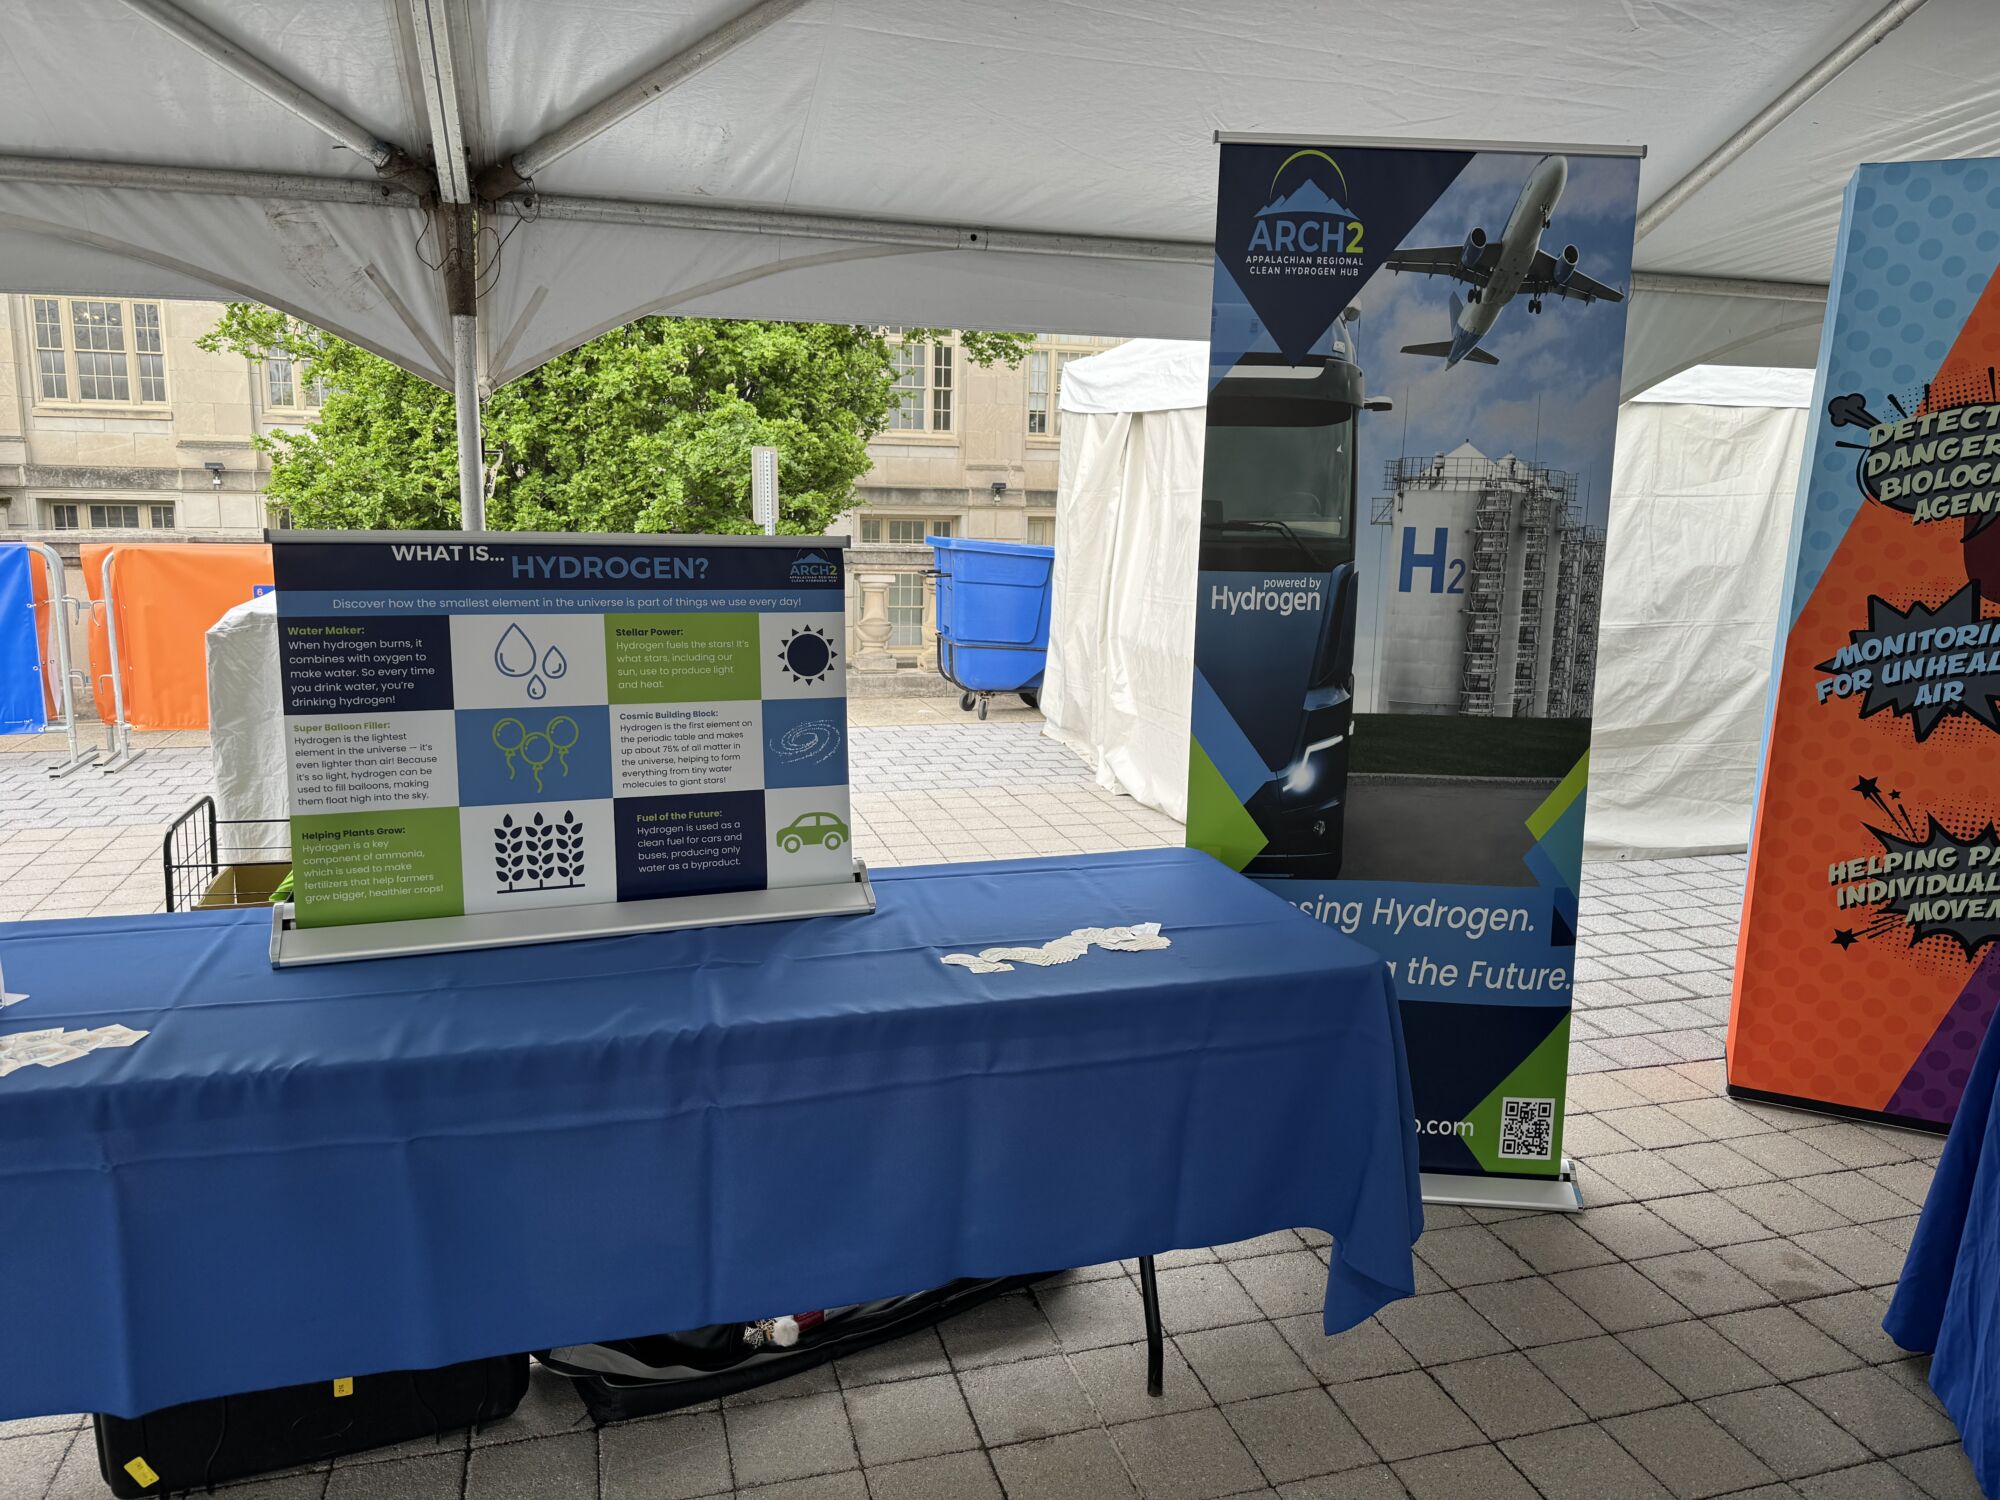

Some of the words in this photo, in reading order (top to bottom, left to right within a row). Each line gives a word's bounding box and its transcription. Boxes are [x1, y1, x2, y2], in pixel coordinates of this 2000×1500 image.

[1248, 220, 1364, 253] ARCH2
[1246, 255, 1312, 264] APPALACHIAN
[1316, 257, 1364, 265] REGIONAL
[1249, 266, 1281, 274] CLEAN
[1285, 267, 1336, 275] HYDROGEN
[1340, 268, 1359, 276] HUB
[391, 545, 464, 562] WHAT
[469, 545, 504, 562] IS...
[512, 556, 708, 579] HYDROGEN?
[790, 564, 838, 576] ARCH2
[1263, 578, 1307, 590] powered
[1309, 577, 1321, 590] by
[333, 599, 385, 608] Discover
[388, 598, 414, 608] how
[417, 598, 436, 608] the
[439, 598, 489, 607] smallest
[491, 598, 540, 607] element
[542, 598, 552, 607] in
[555, 598, 574, 607] the
[577, 598, 624, 607] universe
[626, 598, 635, 606] is
[637, 598, 660, 609] part
[662, 597, 672, 606] of
[675, 597, 708, 609] things
[749, 599, 776, 608] every
[779, 596, 801, 608] day!
[1211, 585, 1321, 616] Hydrogen
[287, 627, 323, 635] Water
[325, 626, 364, 635] Maker:
[615, 628, 648, 636] Stellar
[650, 628, 683, 636] Power:
[288, 640, 320, 649] When
[323, 640, 377, 651] hydrogen
[379, 639, 413, 649] burns,
[415, 639, 422, 648] it
[289, 654, 344, 663] combines
[347, 653, 370, 662] with
[373, 655, 412, 664] oxygen
[415, 653, 426, 661] to
[290, 669, 322, 678] make
[324, 669, 359, 677] water.
[361, 668, 375, 676] So
[377, 669, 408, 678] every
[410, 667, 435, 675] time
[290, 685, 311, 694] you
[314, 682, 342, 691] drink
[344, 683, 378, 691] water,
[380, 681, 414, 692] you're
[1816, 668, 1872, 702] FOR
[1914, 680, 1964, 706] AIR
[291, 697, 336, 708] drinking
[339, 696, 395, 707] hydrogen!
[619, 712, 653, 720] Cosmic
[655, 711, 691, 720] Building
[692, 709, 718, 718] Block:
[293, 725, 322, 734] Super
[324, 722, 362, 731] Balloon
[363, 721, 390, 729] Filler:
[620, 723, 662, 733] Hydrogen
[664, 722, 671, 730] is
[688, 721, 704, 729] first
[706, 720, 740, 728] element
[294, 736, 341, 746] Hydrogen
[353, 734, 369, 742] the
[371, 733, 407, 744] lightest
[620, 735, 635, 743] the
[636, 734, 672, 744] periodic
[674, 733, 696, 741] table
[697, 732, 714, 740] and
[716, 731, 744, 739] makes
[634, 746, 660, 754] about
[662, 745, 679, 753] 75%
[681, 744, 689, 752] of
[321, 759, 352, 770] lighter
[354, 758, 377, 766] than
[621, 758, 636, 766] the
[677, 755, 709, 764] helping
[721, 753, 740, 761] form
[296, 773, 310, 781] it's
[325, 771, 349, 781] light,
[351, 770, 397, 780] hydrogen
[622, 768, 668, 778] everything
[669, 767, 690, 775] from
[691, 766, 707, 775] tiny
[622, 780, 667, 788] molecules
[679, 778, 701, 788] giant
[703, 777, 726, 785] stars!
[636, 813, 657, 822] Fuel
[658, 812, 669, 820] of
[670, 812, 687, 820] the
[302, 831, 341, 841] Helping
[343, 829, 375, 837] Plants
[376, 828, 405, 836] Grow:
[637, 826, 684, 836] Hydrogen
[695, 822, 718, 830] used
[637, 839, 665, 847] clean
[666, 836, 684, 845] fuel
[686, 836, 699, 844] for
[724, 832, 742, 841] and
[671, 848, 719, 860] producing
[721, 846, 740, 855] only
[690, 857, 741, 869] byproduct.
[1828, 847, 1957, 883] HELPING
[1372, 898, 1534, 939] Hydrogen.
[1407, 956, 1458, 987] the
[1467, 960, 1571, 991] Future.
